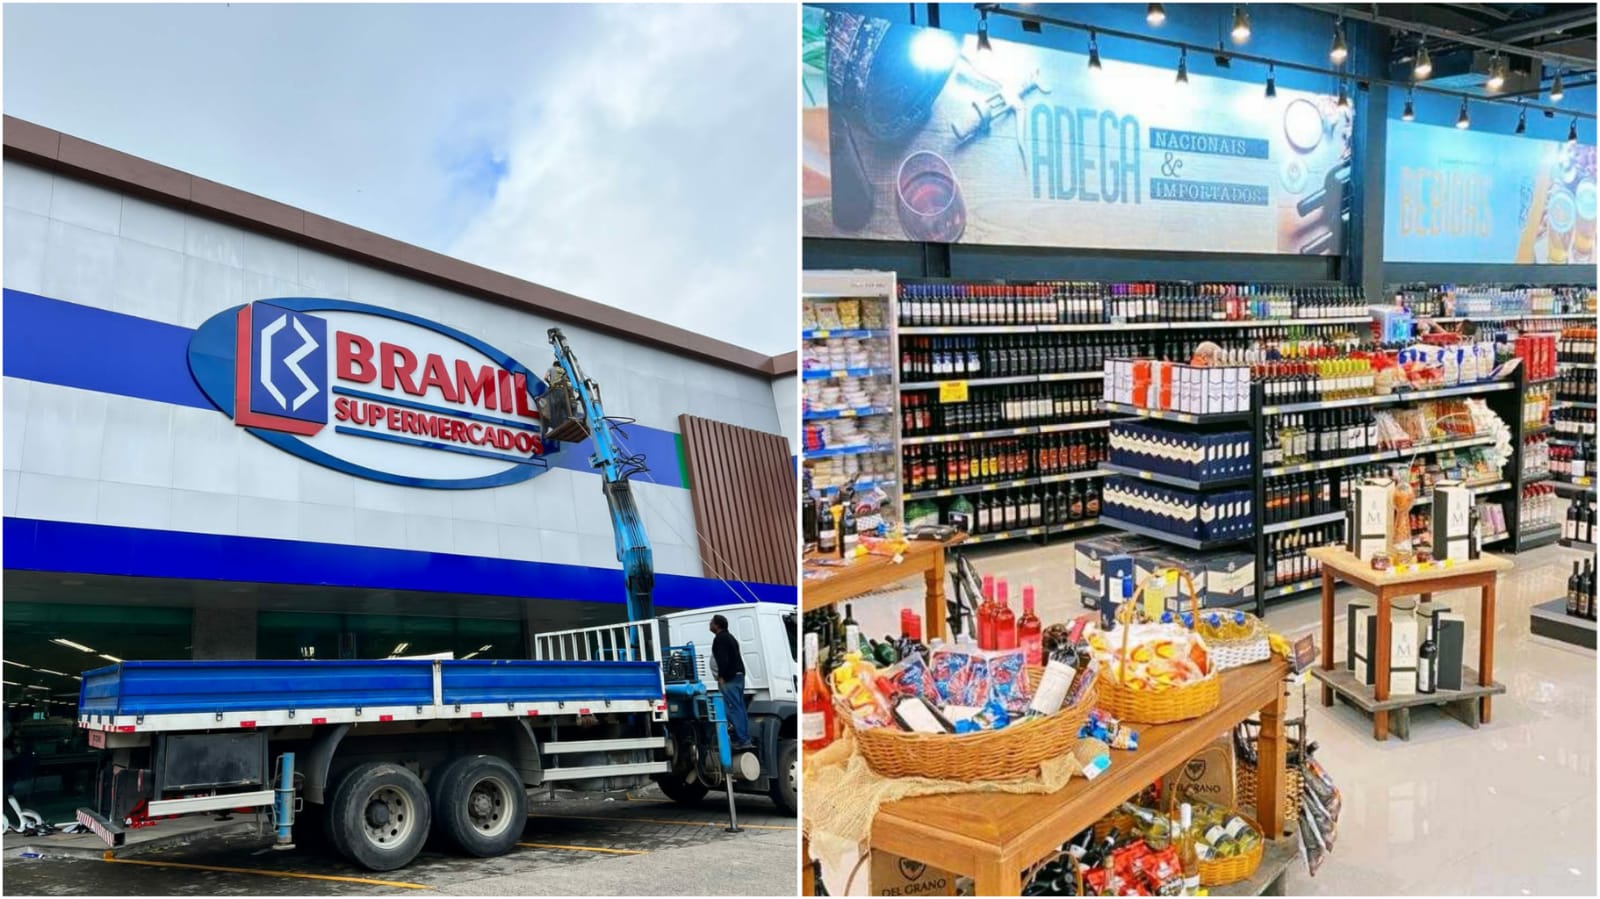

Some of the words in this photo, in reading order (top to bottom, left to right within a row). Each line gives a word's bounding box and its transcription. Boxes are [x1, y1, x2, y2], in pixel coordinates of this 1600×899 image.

[1031, 103, 1141, 204] ADEGA
[1154, 130, 1247, 155] NACIONAIS
[1161, 151, 1183, 177] &
[1155, 182, 1263, 201] IMPORTADOS
[336, 331, 541, 419] BRAMIL
[334, 397, 544, 455] SUPERMERCADOS
[904, 879, 947, 895] GRANO
